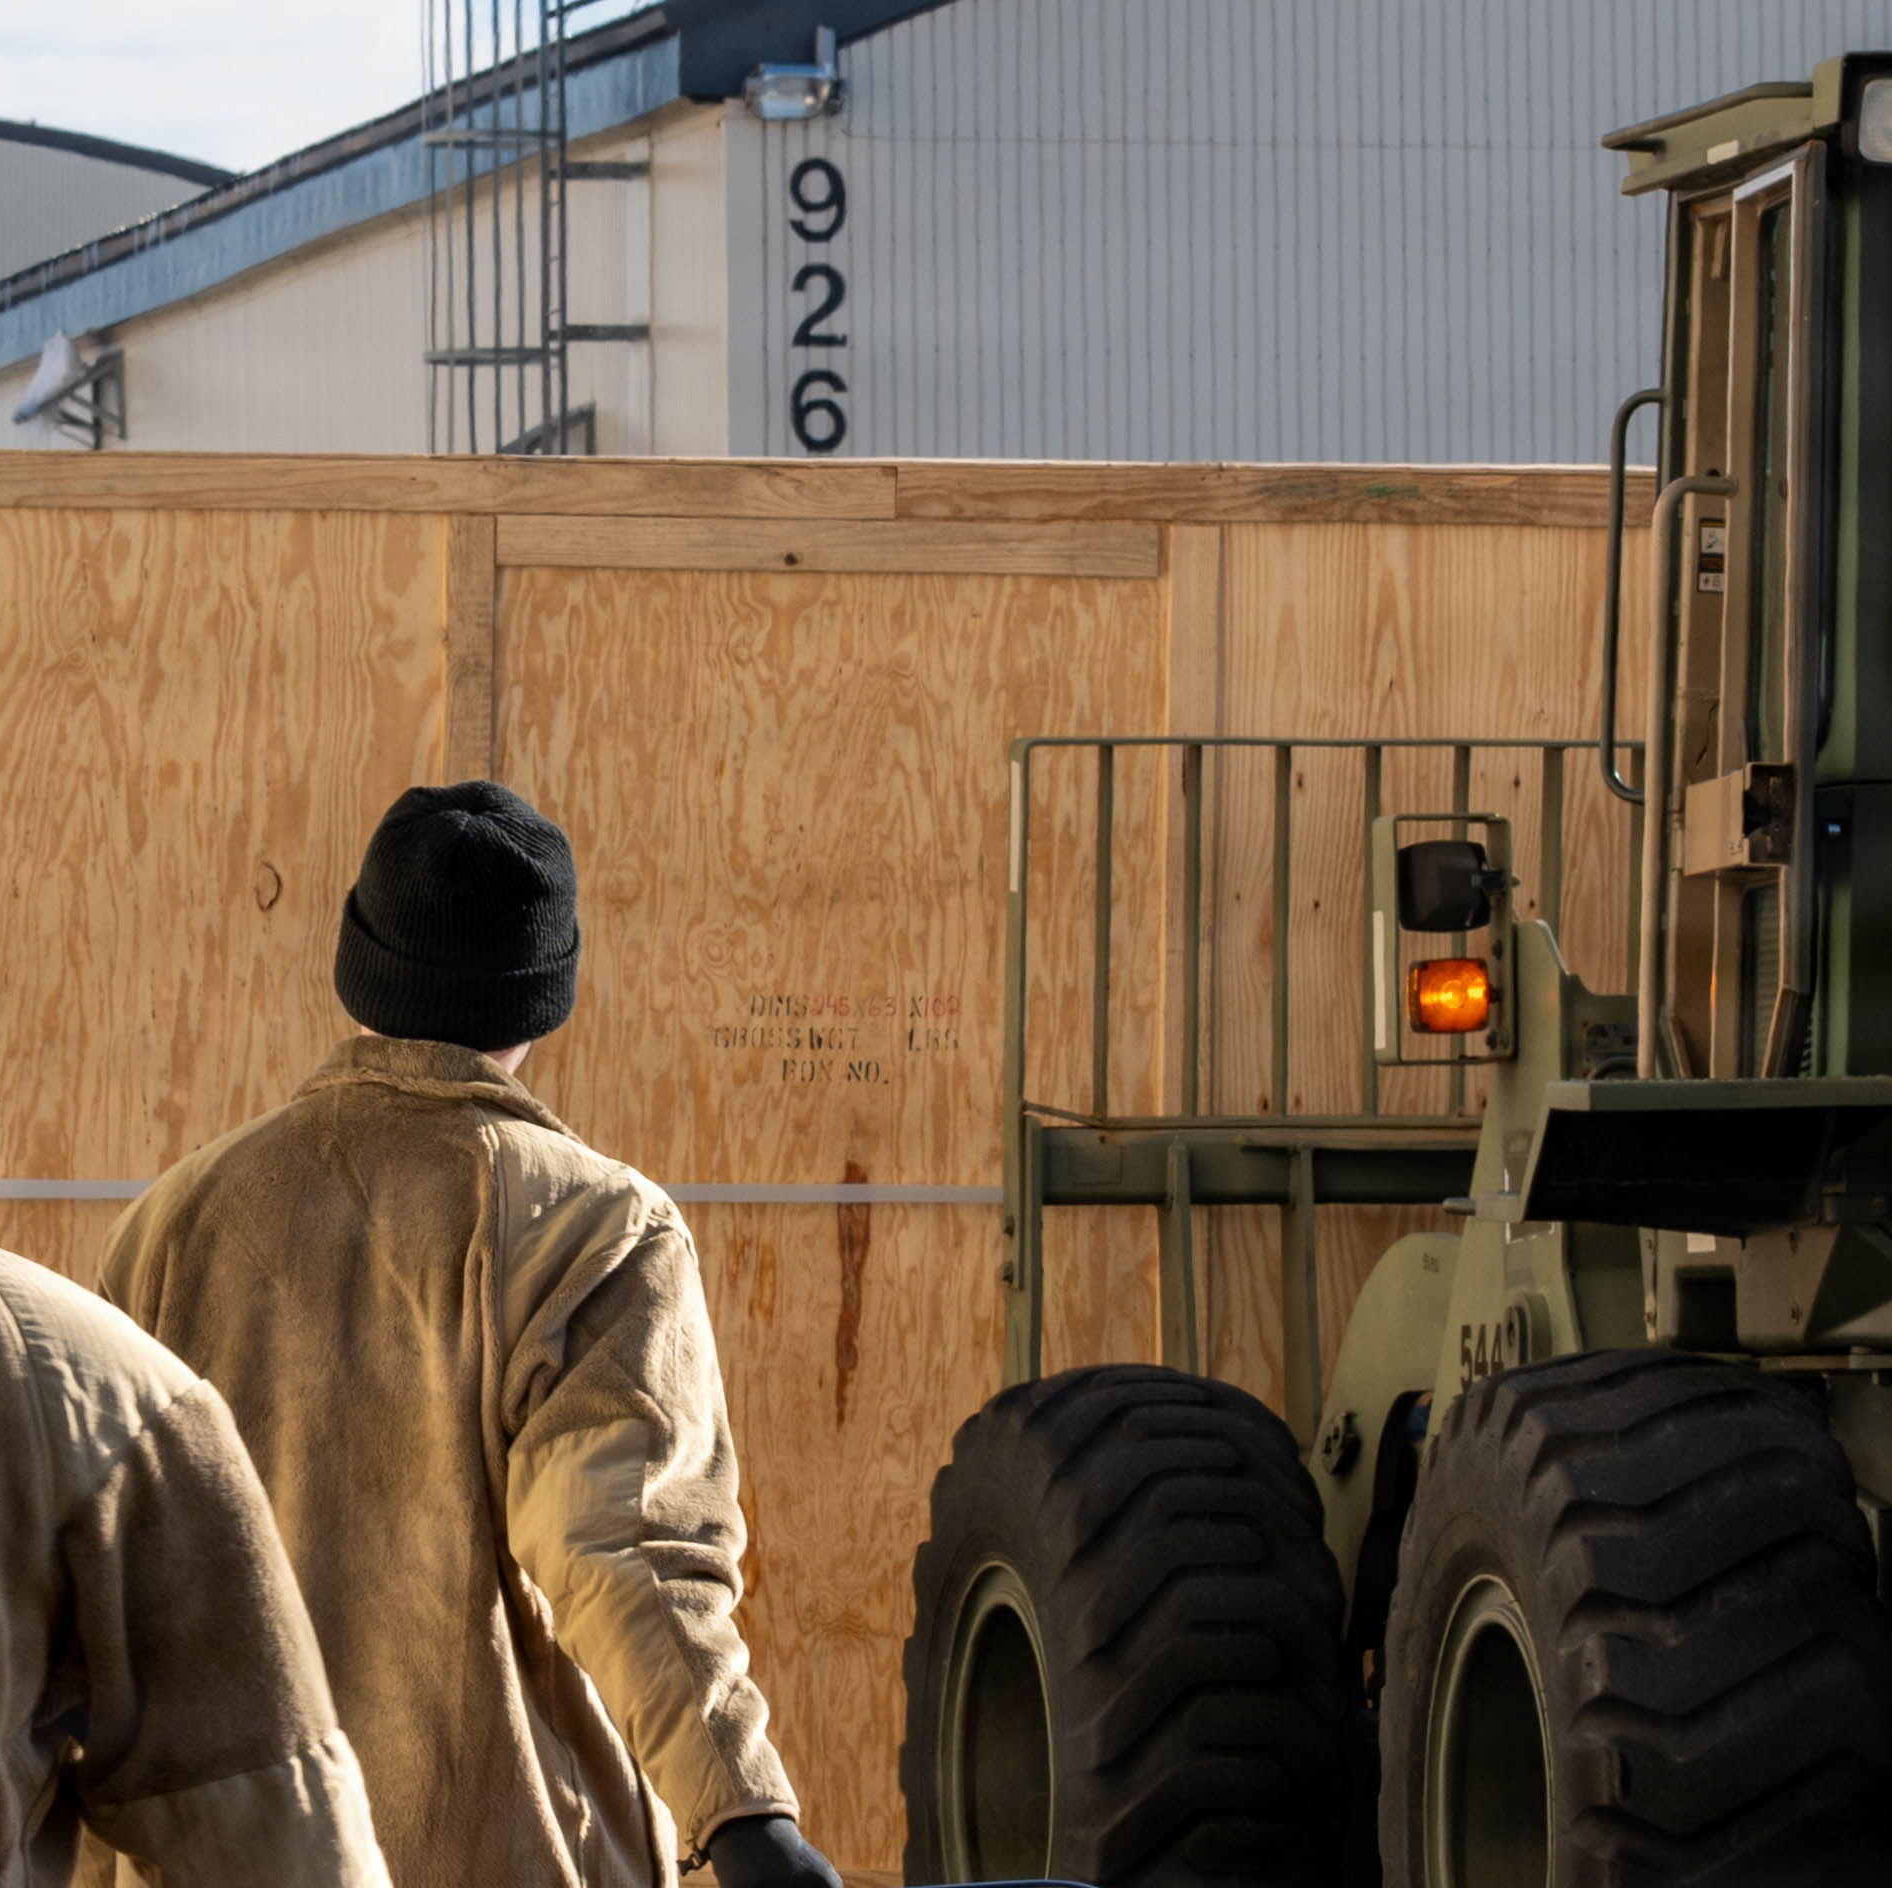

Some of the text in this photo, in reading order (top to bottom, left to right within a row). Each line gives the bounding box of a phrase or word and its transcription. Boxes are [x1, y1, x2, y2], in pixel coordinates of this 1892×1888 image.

[789, 157, 848, 454] 926
[750, 995, 807, 1018] DIMS
[1460, 1322, 1505, 1394] 544
